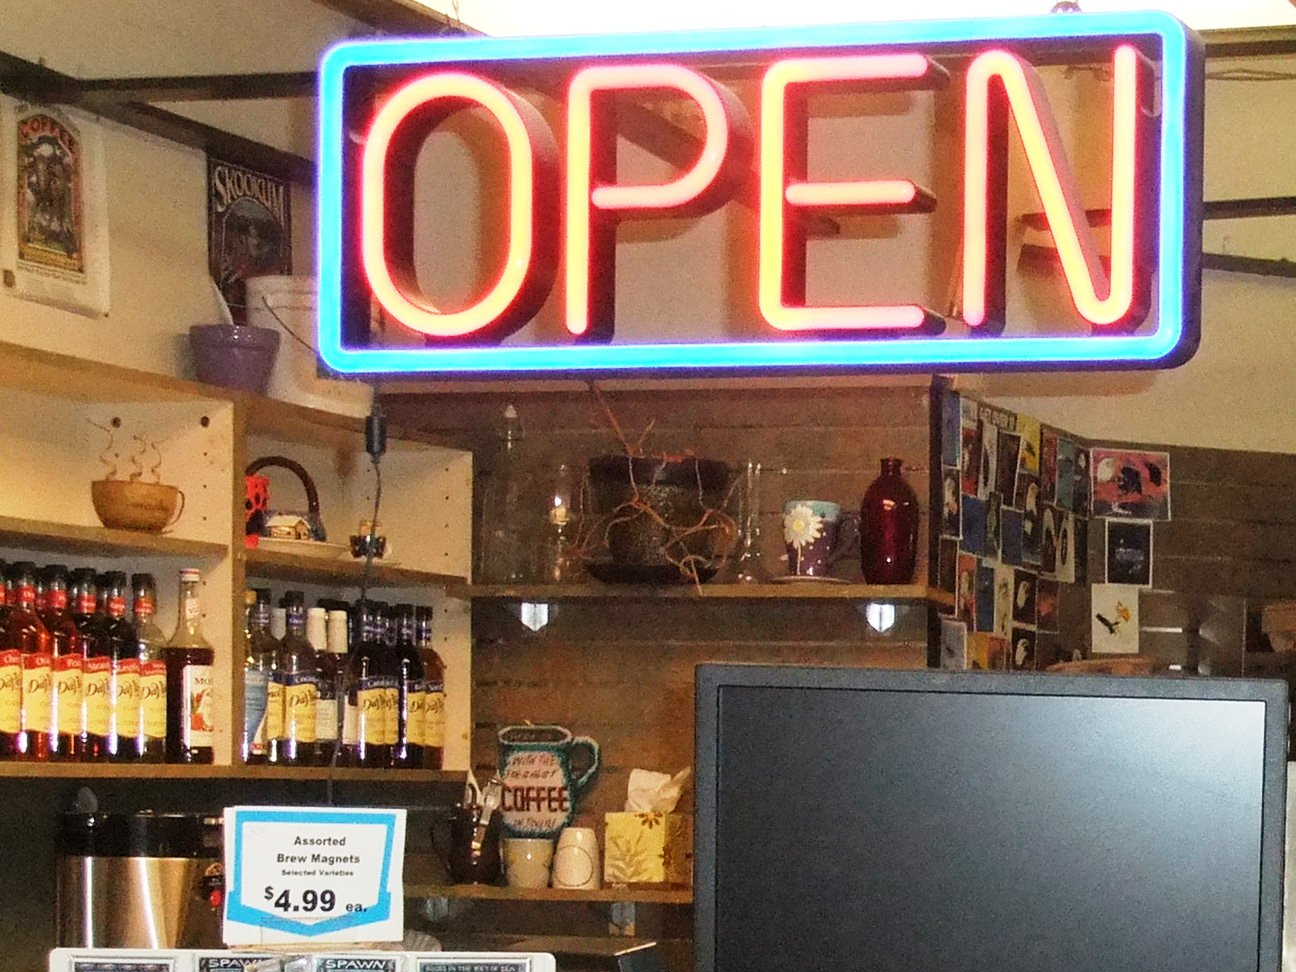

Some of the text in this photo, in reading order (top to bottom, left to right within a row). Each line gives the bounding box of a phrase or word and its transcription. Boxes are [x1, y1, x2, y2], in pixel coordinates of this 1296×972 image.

[214, 166, 286, 229] SKOOKUM
[361, 45, 1138, 337] OPEN
[502, 786, 568, 812] COFFEE
[294, 836, 346, 846] Assorted
[277, 854, 360, 865] Brew Magnets
[264, 886, 367, 912] $4.99 ea.
[209, 958, 259, 968] SPAW
[325, 959, 386, 970] SPAWN
